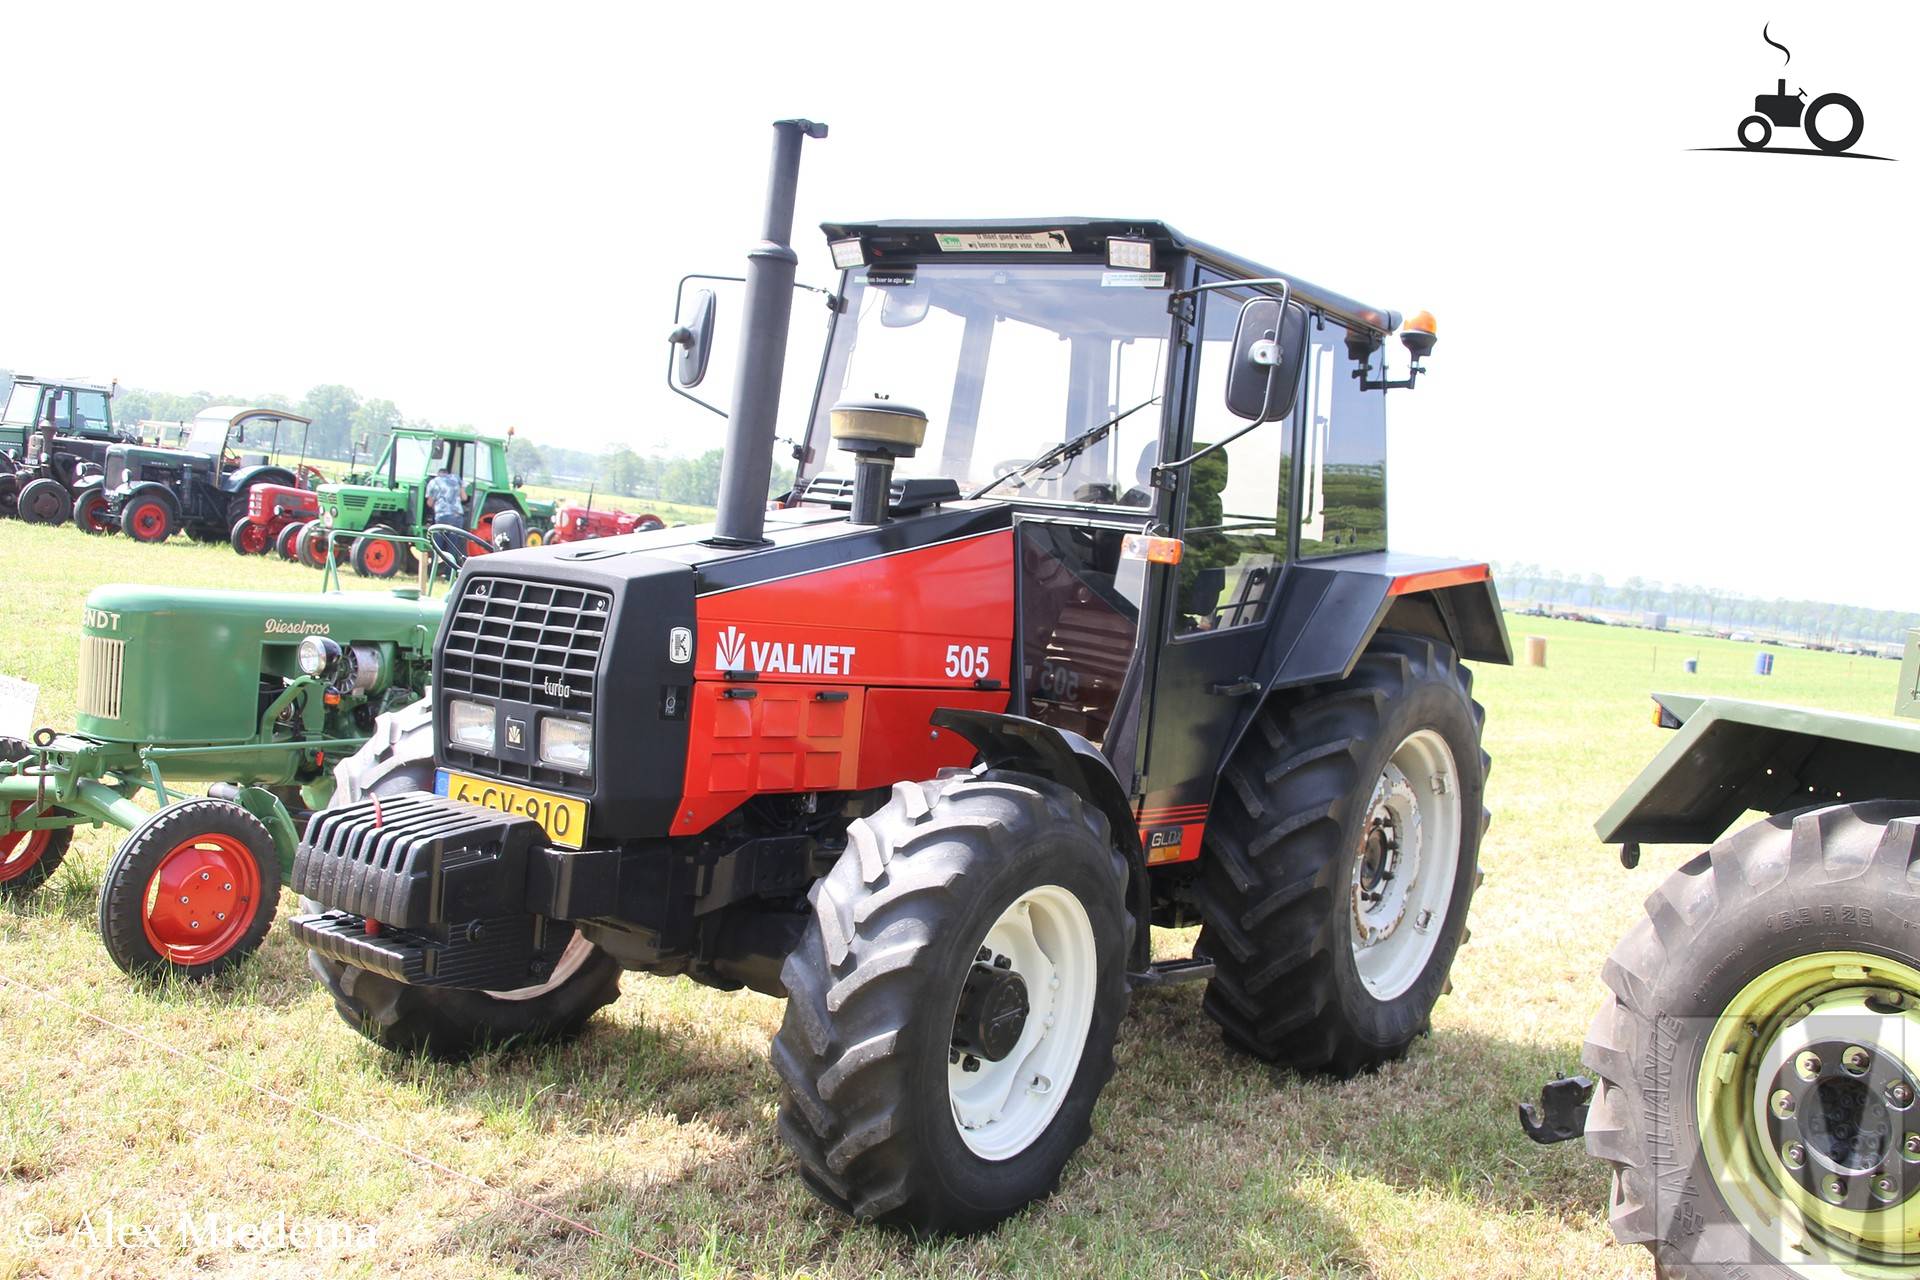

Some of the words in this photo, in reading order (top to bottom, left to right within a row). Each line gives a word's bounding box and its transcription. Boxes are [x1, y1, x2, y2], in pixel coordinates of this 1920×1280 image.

[264, 618, 330, 634] Dieselross
[751, 641, 855, 675] VALMET
[945, 645, 989, 678] 505
[544, 675, 571, 698] turbo
[1642, 1008, 1700, 1198] ALLIANCE
